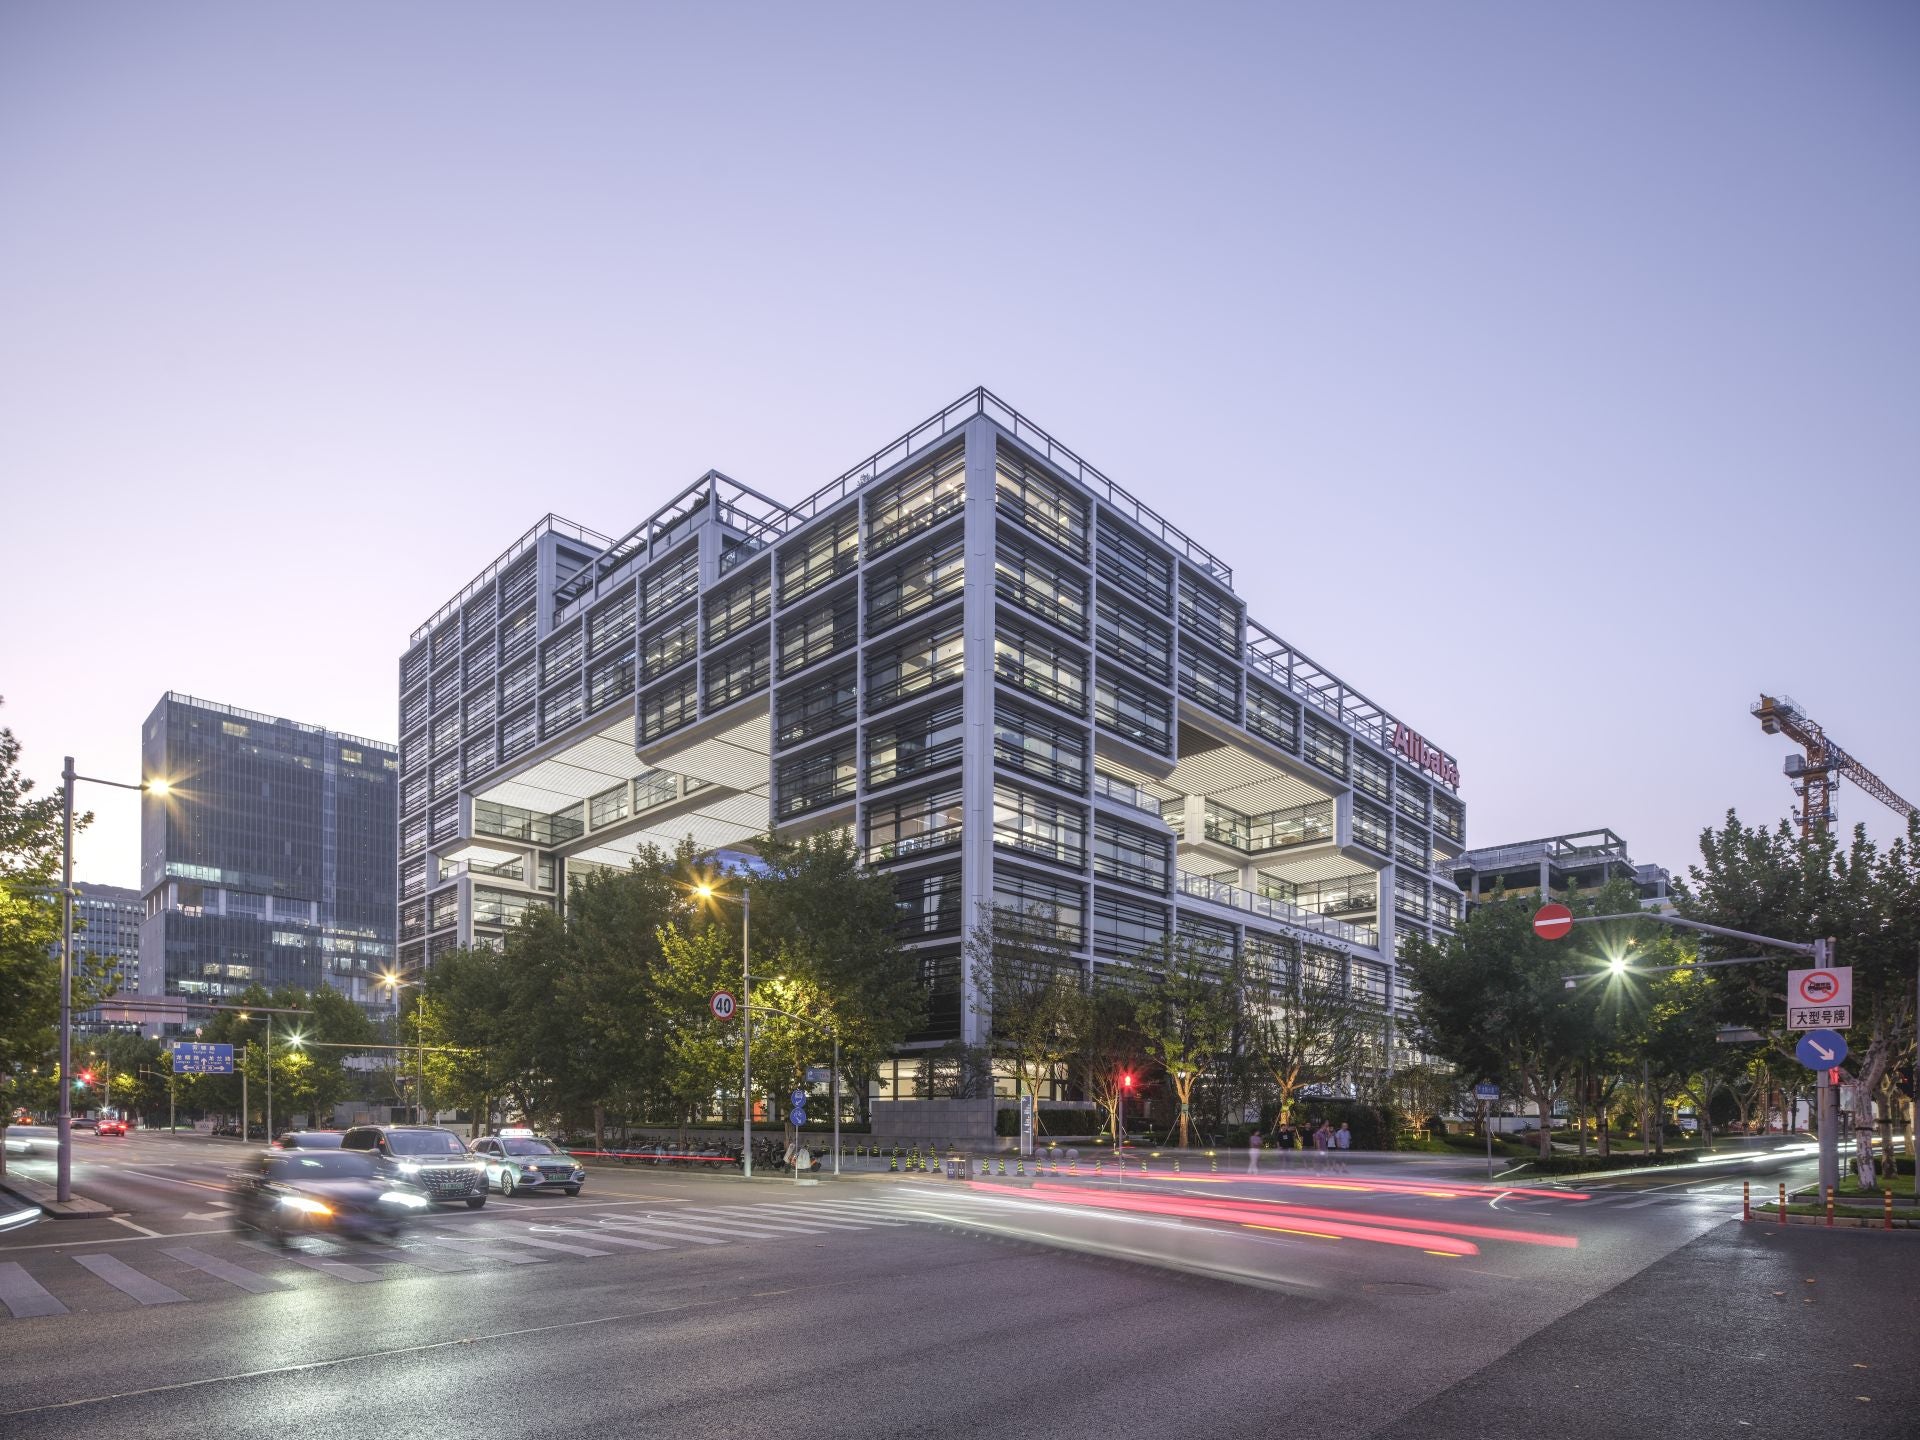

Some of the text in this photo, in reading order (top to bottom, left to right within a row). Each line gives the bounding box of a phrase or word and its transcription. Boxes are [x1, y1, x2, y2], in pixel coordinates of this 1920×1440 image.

[1393, 723, 1460, 788] Alibaba
[716, 998, 731, 1014] 40
[1796, 1009, 1846, 1025] 大型号牌
